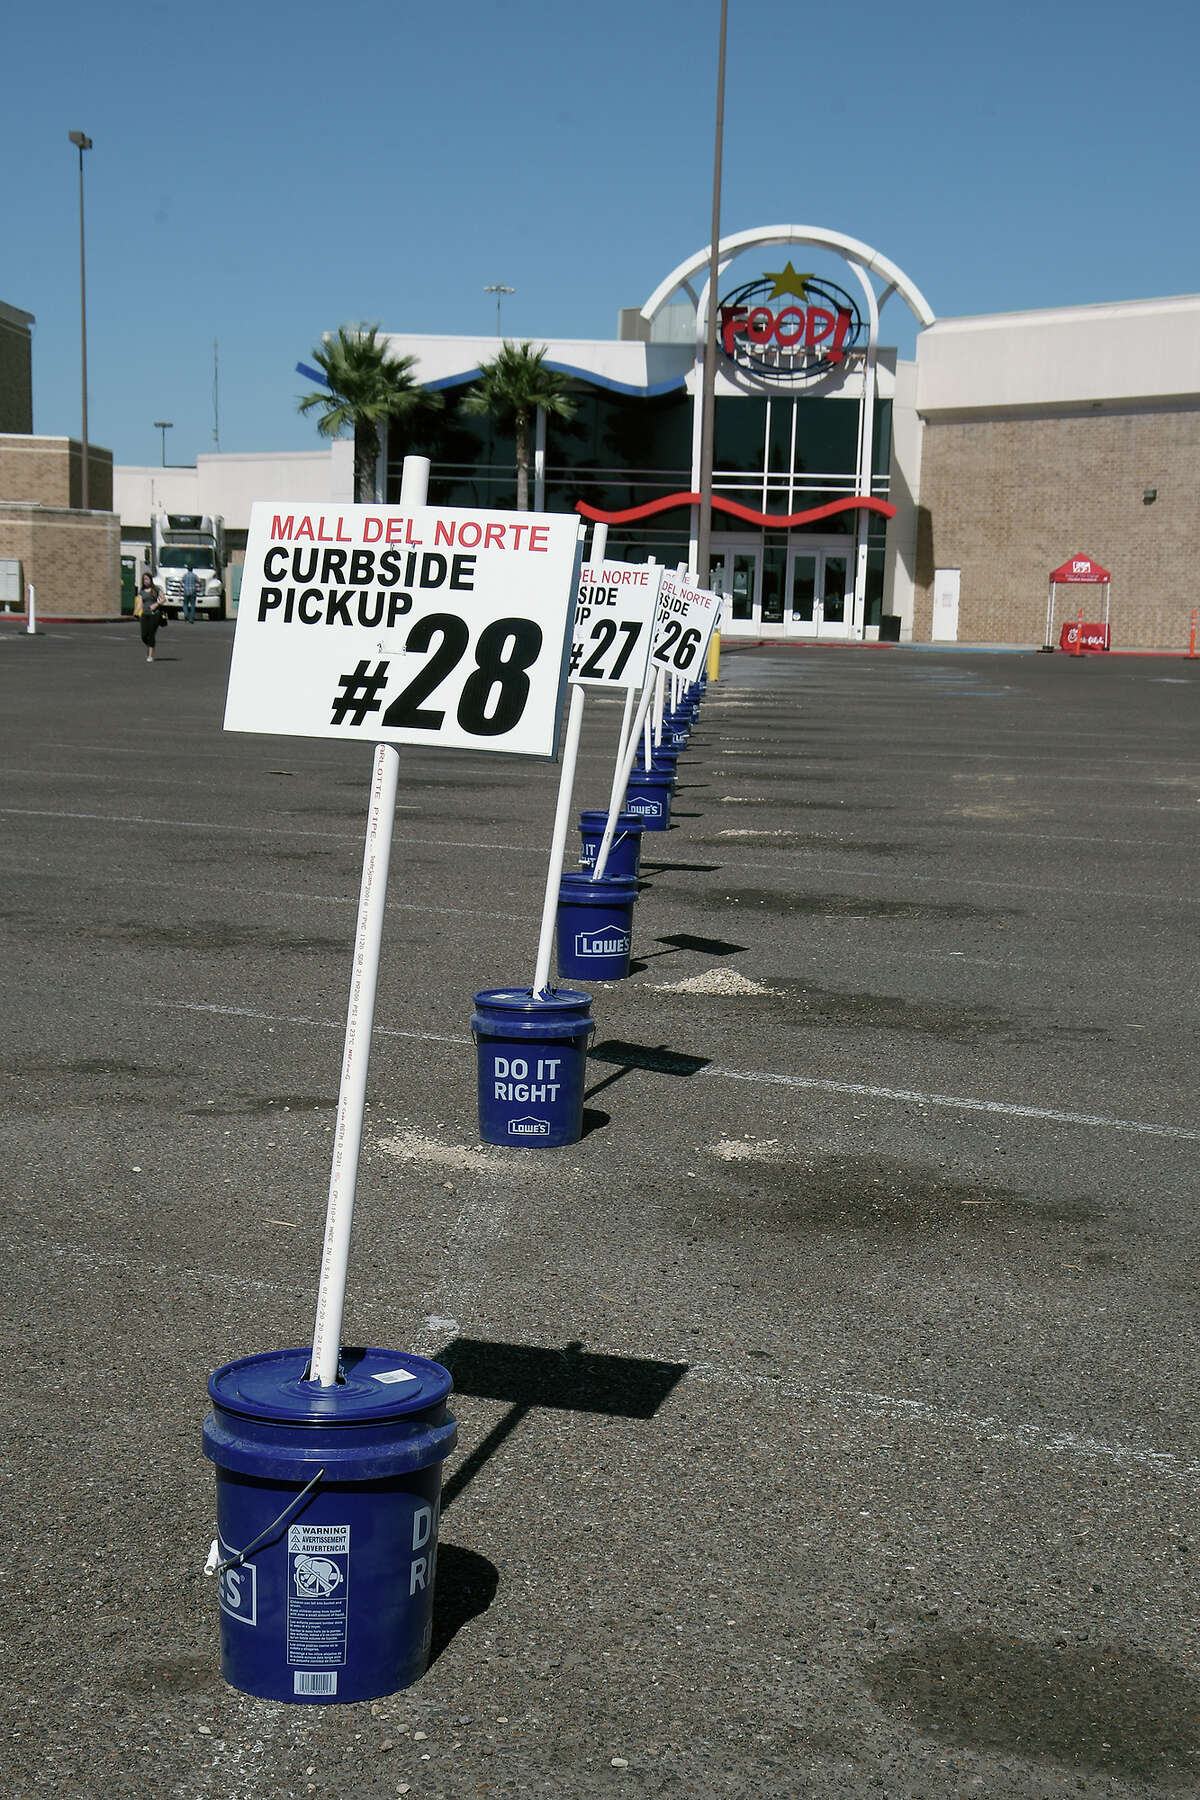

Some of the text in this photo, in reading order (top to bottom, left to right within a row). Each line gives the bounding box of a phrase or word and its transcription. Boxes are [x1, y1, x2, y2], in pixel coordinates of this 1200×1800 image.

[721, 306, 853, 363] FOOD!
[271, 515, 550, 552] MALL DEL NORTE
[264, 546, 477, 591] CURBSIDE
[579, 569, 598, 584] EL
[601, 570, 649, 585] NORTE
[661, 580, 712, 609] DEL NORTE
[258, 587, 413, 628] PICKUP
[330, 612, 543, 736] #28
[582, 937, 630, 954] LOWE'S
[494, 1057, 561, 1081] DO IT
[494, 1081, 561, 1102] RIGHT
[512, 1121, 546, 1134] LOWE'S
[301, 1527, 347, 1535] WARNING
[301, 1535, 347, 1543] AVERTISSEMENT
[301, 1544, 346, 1552] ADVERTENCIA
